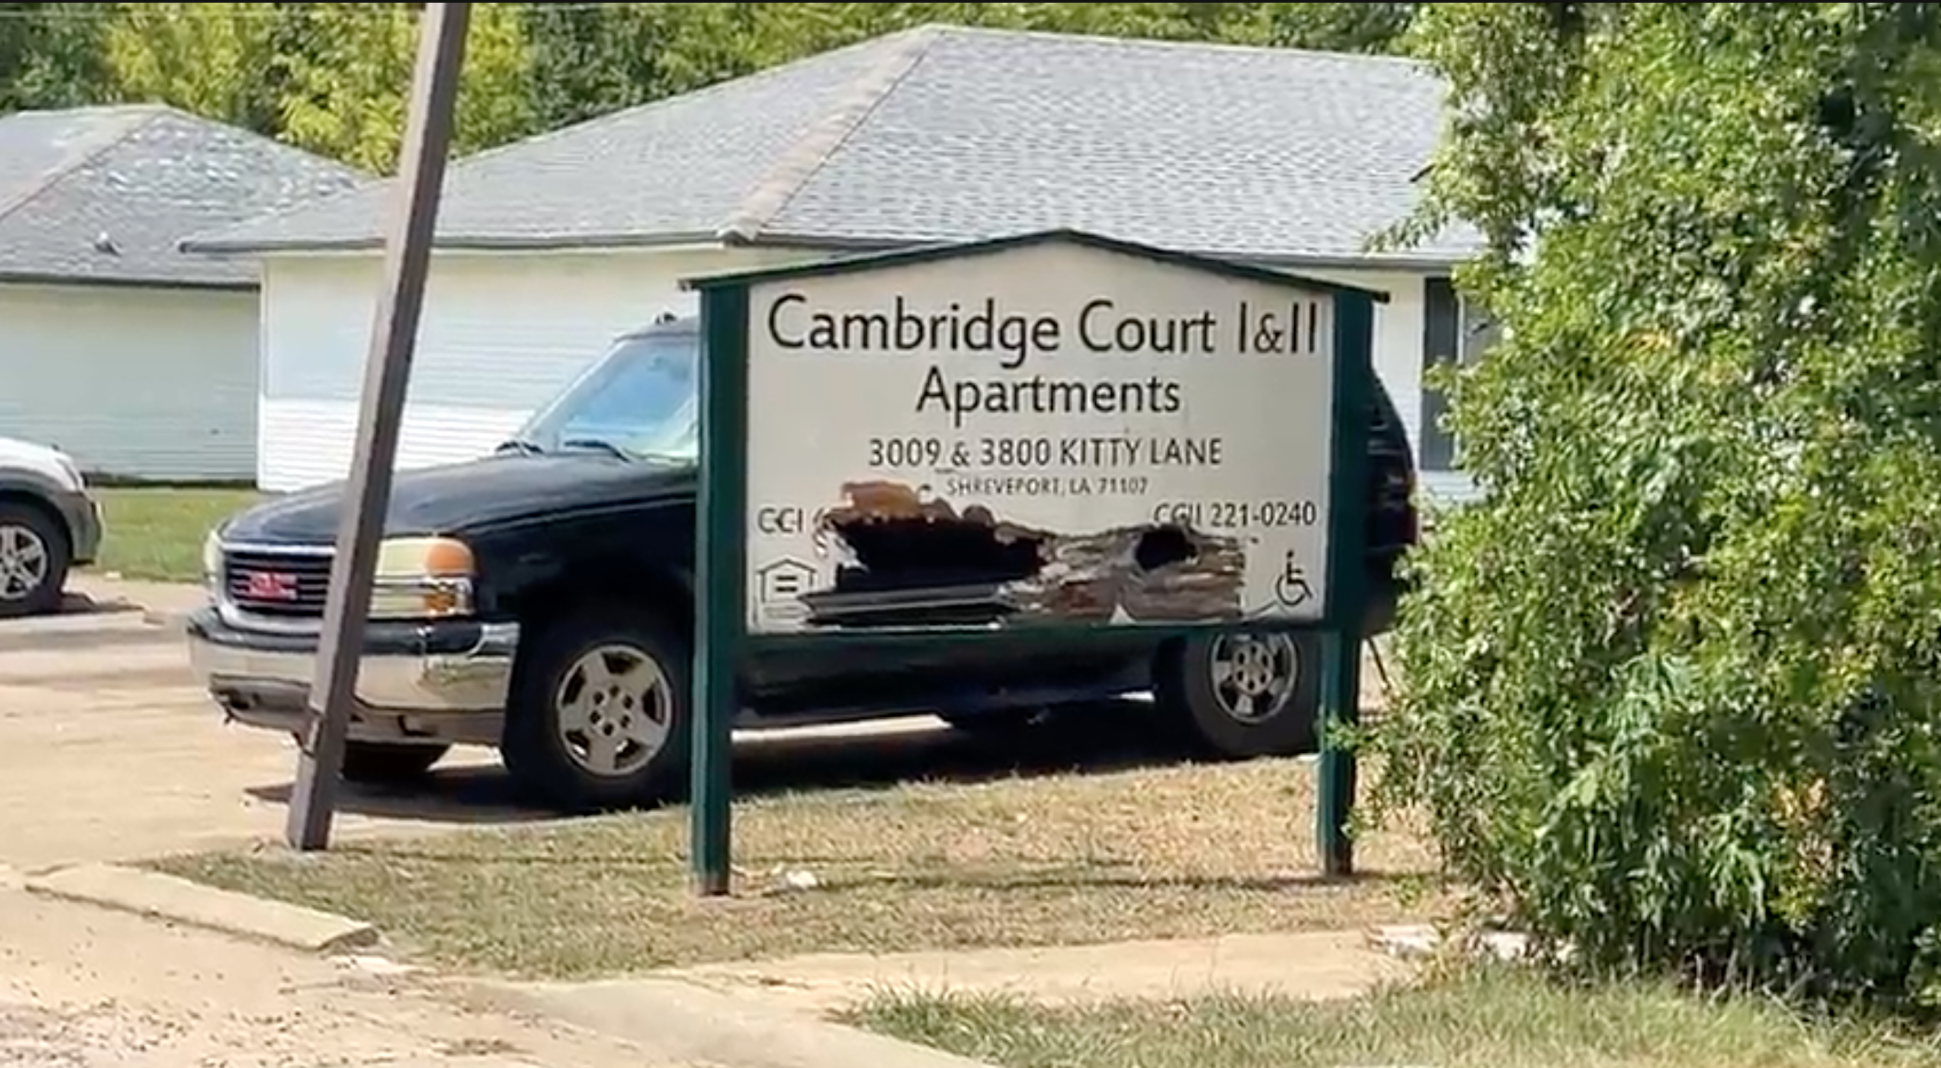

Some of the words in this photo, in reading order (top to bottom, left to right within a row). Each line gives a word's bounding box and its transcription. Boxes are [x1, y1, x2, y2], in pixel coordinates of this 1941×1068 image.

[768, 294, 1060, 369] Cambridge
[1078, 300, 1216, 353] Court
[916, 366, 1181, 427] Apartments
[869, 438, 941, 467] 3009
[951, 441, 970, 467] &
[980, 438, 1051, 466] 3800
[1060, 438, 1142, 466] KITTY
[1150, 438, 1222, 465] LANE
[947, 477, 1065, 497] SHREVEPORT,
[1069, 478, 1091, 495] LA
[1099, 477, 1148, 495] 71107
[1210, 501, 1317, 527] 221-0240
